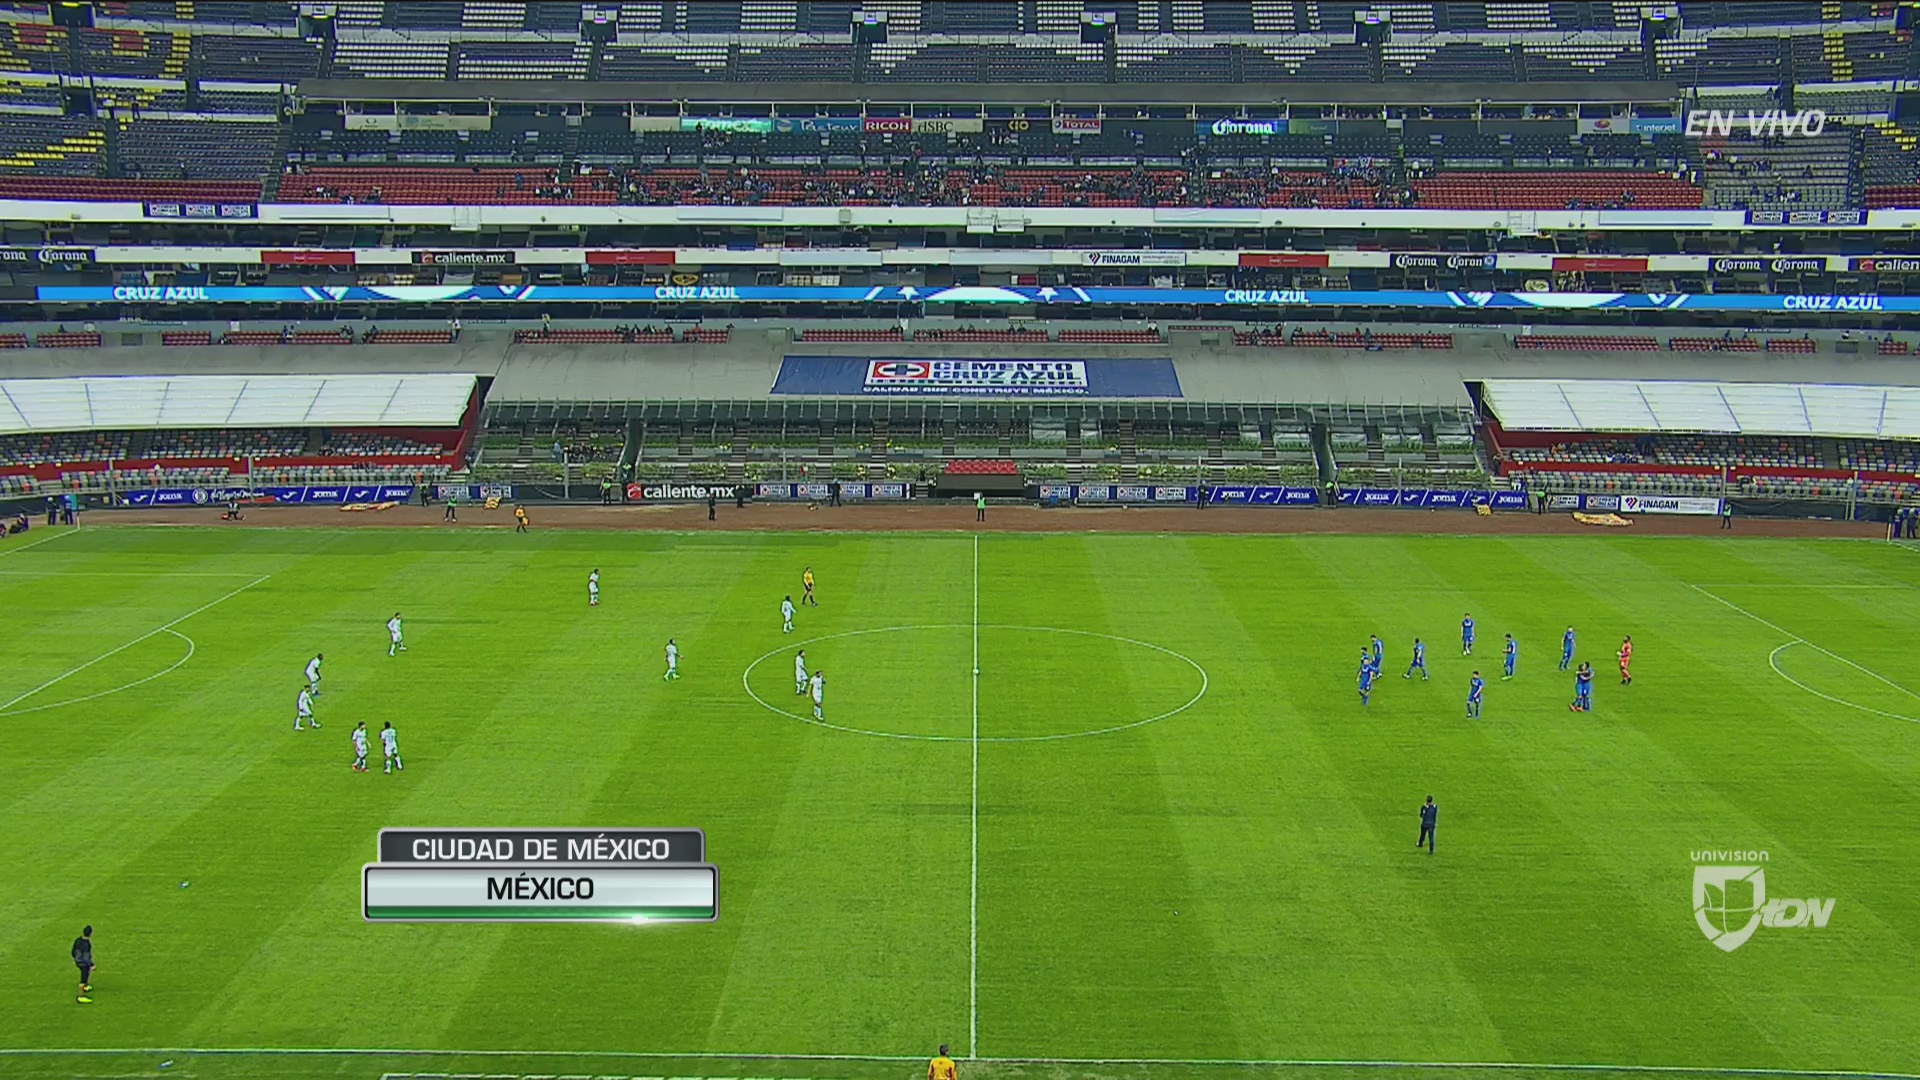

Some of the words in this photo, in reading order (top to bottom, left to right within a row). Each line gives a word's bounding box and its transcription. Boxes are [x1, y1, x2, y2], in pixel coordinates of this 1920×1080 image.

[800, 119, 858, 132] Pateur
[865, 122, 910, 131] RICOH
[1065, 121, 1099, 130] TOTAL
[1212, 119, 1275, 135] Corona
[38, 249, 90, 264] Corona
[435, 252, 506, 264] caliente.mx
[1102, 255, 1141, 265] FINAGAM
[1396, 254, 1438, 269] Corona
[1447, 254, 1484, 270] Coron
[1714, 258, 1762, 273] Corona
[1771, 258, 1819, 274] Corona
[113, 286, 161, 300] CRUZ
[165, 286, 209, 300] AZUL
[655, 286, 697, 299] CRUZ
[700, 286, 740, 299] AZUL
[1224, 290, 1267, 303] CRUZ
[1270, 290, 1310, 303] AZUL
[1783, 295, 1831, 309] CRUZ
[1835, 295, 1883, 310] AZUL
[933, 362, 1073, 371] CEMENTO
[933, 371, 1006, 380] CRUZ
[1011, 371, 1081, 380] AZUL
[643, 484, 735, 499] caliente.mx
[1638, 500, 1679, 510] FINAGAM
